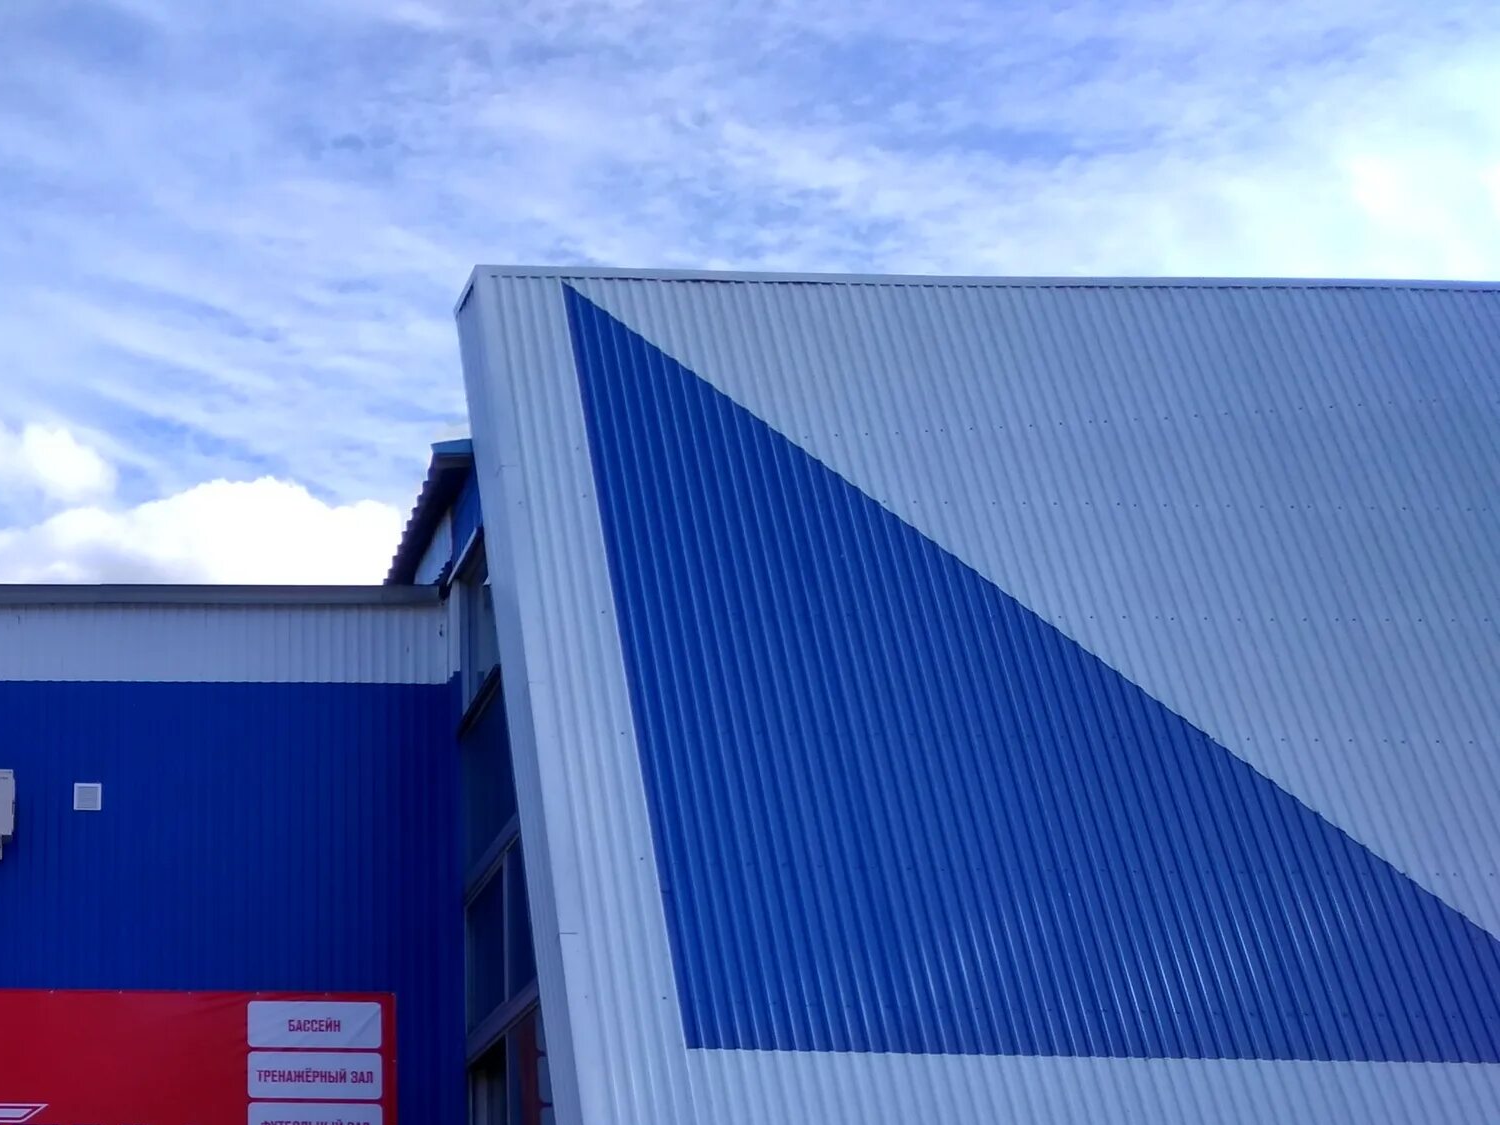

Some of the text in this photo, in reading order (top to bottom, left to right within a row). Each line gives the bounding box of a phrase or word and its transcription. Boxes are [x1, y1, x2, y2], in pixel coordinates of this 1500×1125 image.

[288, 1017, 341, 1032] БАССЕЙН
[256, 1068, 374, 1084] ТРЕНАЖЁРНЫЙ ЗАЛ
